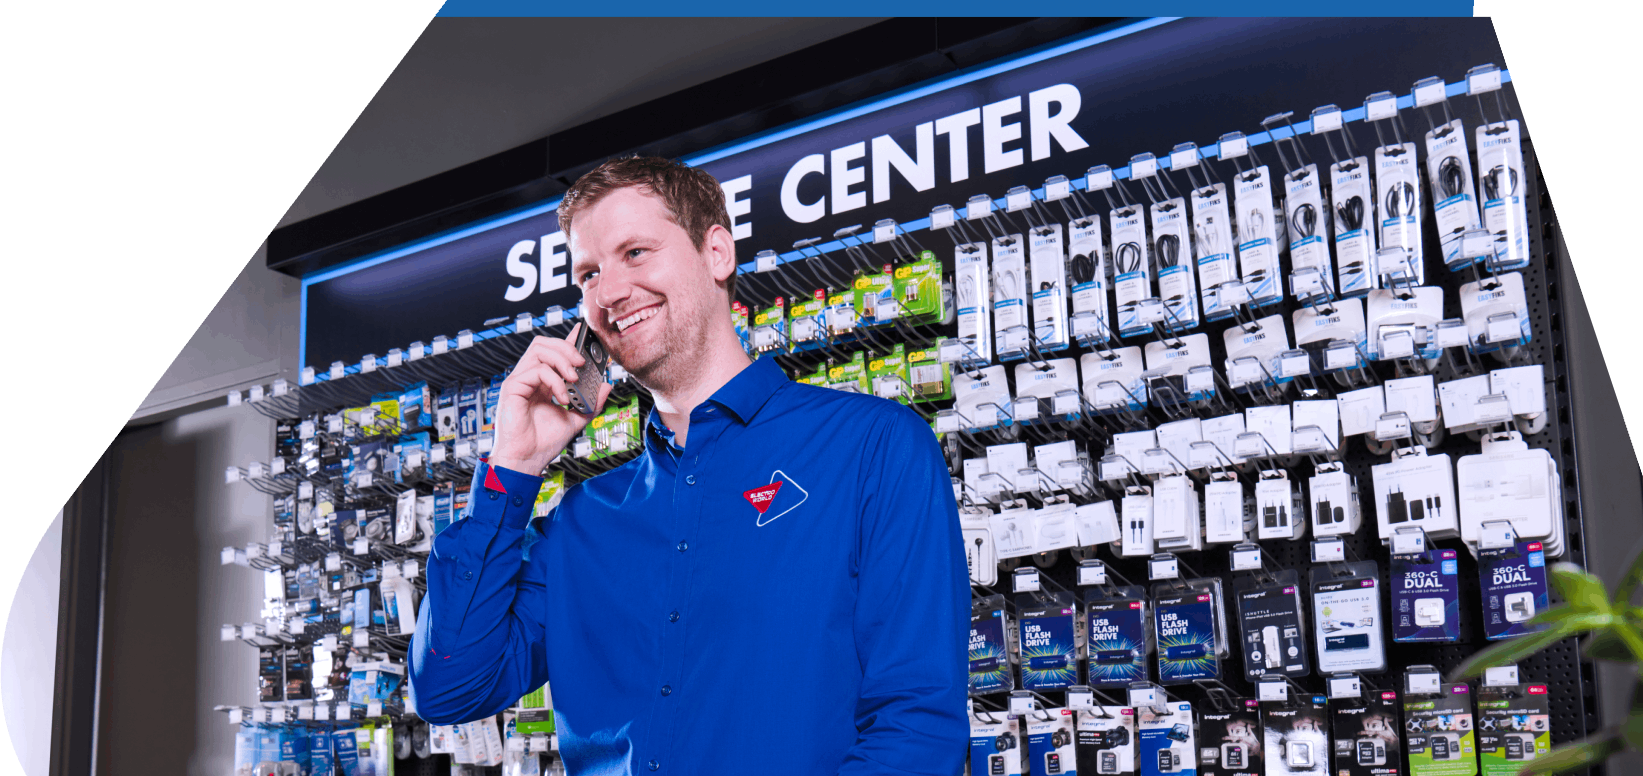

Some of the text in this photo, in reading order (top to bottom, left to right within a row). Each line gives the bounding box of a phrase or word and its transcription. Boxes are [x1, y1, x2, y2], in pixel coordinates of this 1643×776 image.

[1483, 137, 1512, 148] EASYFIKS
[780, 83, 1090, 224] CENTER
[1337, 173, 1362, 184] EASYFIKS
[1198, 199, 1221, 210] EASYFIKS
[1157, 213, 1179, 223] EASYFIKS
[895, 266, 912, 279] GP
[855, 278, 872, 290] GP
[829, 295, 843, 305] GP
[1477, 290, 1506, 302] EASYFIKS
[791, 305, 805, 316] GP
[755, 313, 768, 325] GP
[1315, 316, 1341, 326] EASYFIKS
[1243, 333, 1266, 344] EASYFIKS
[908, 351, 926, 363] GP
[1165, 350, 1189, 359] EASYFIKS
[869, 359, 885, 371] GP
[1100, 362, 1123, 370] EASYFIKS
[829, 367, 844, 378] GP
[971, 381, 990, 389] EASYFIKS
[1493, 564, 1526, 575] 360-C
[1405, 571, 1438, 579] 360-C
[1493, 571, 1531, 585] DUAL
[1404, 577, 1443, 589] DUAL
[1161, 613, 1178, 621] USB
[1025, 625, 1041, 633] USB
[1093, 625, 1119, 633] FLASH
[1161, 619, 1188, 629] FLASH
[970, 629, 978, 637] SB
[1025, 631, 1051, 640] FLASH
[1162, 627, 1187, 636] DRIVE
[969, 634, 986, 643] LASH
[1026, 638, 1050, 647] DRIVE
